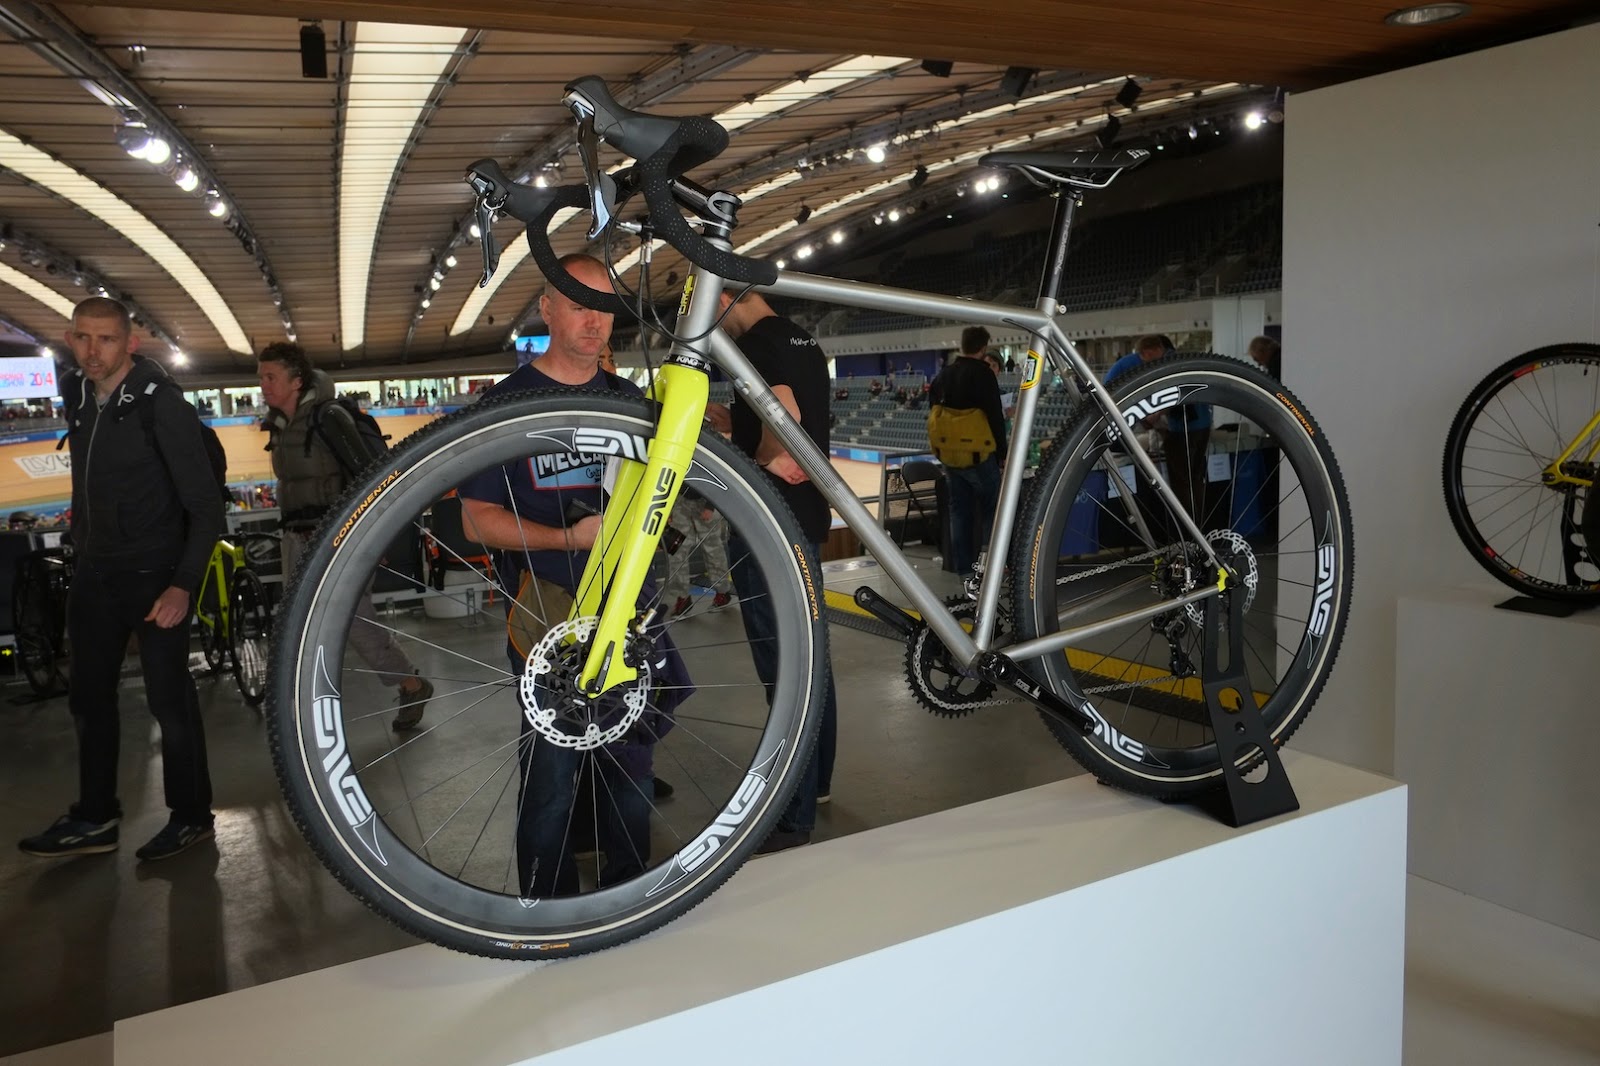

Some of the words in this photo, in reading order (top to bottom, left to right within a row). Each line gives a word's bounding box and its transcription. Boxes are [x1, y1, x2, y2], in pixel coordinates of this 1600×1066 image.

[676, 355, 699, 366] KING
[1275, 392, 1315, 437] CONTINENTAL
[333, 469, 402, 547] CONTINENTAL
[794, 543, 819, 621] CONTINENTAL
[1029, 525, 1042, 600] CONTINENTAL
